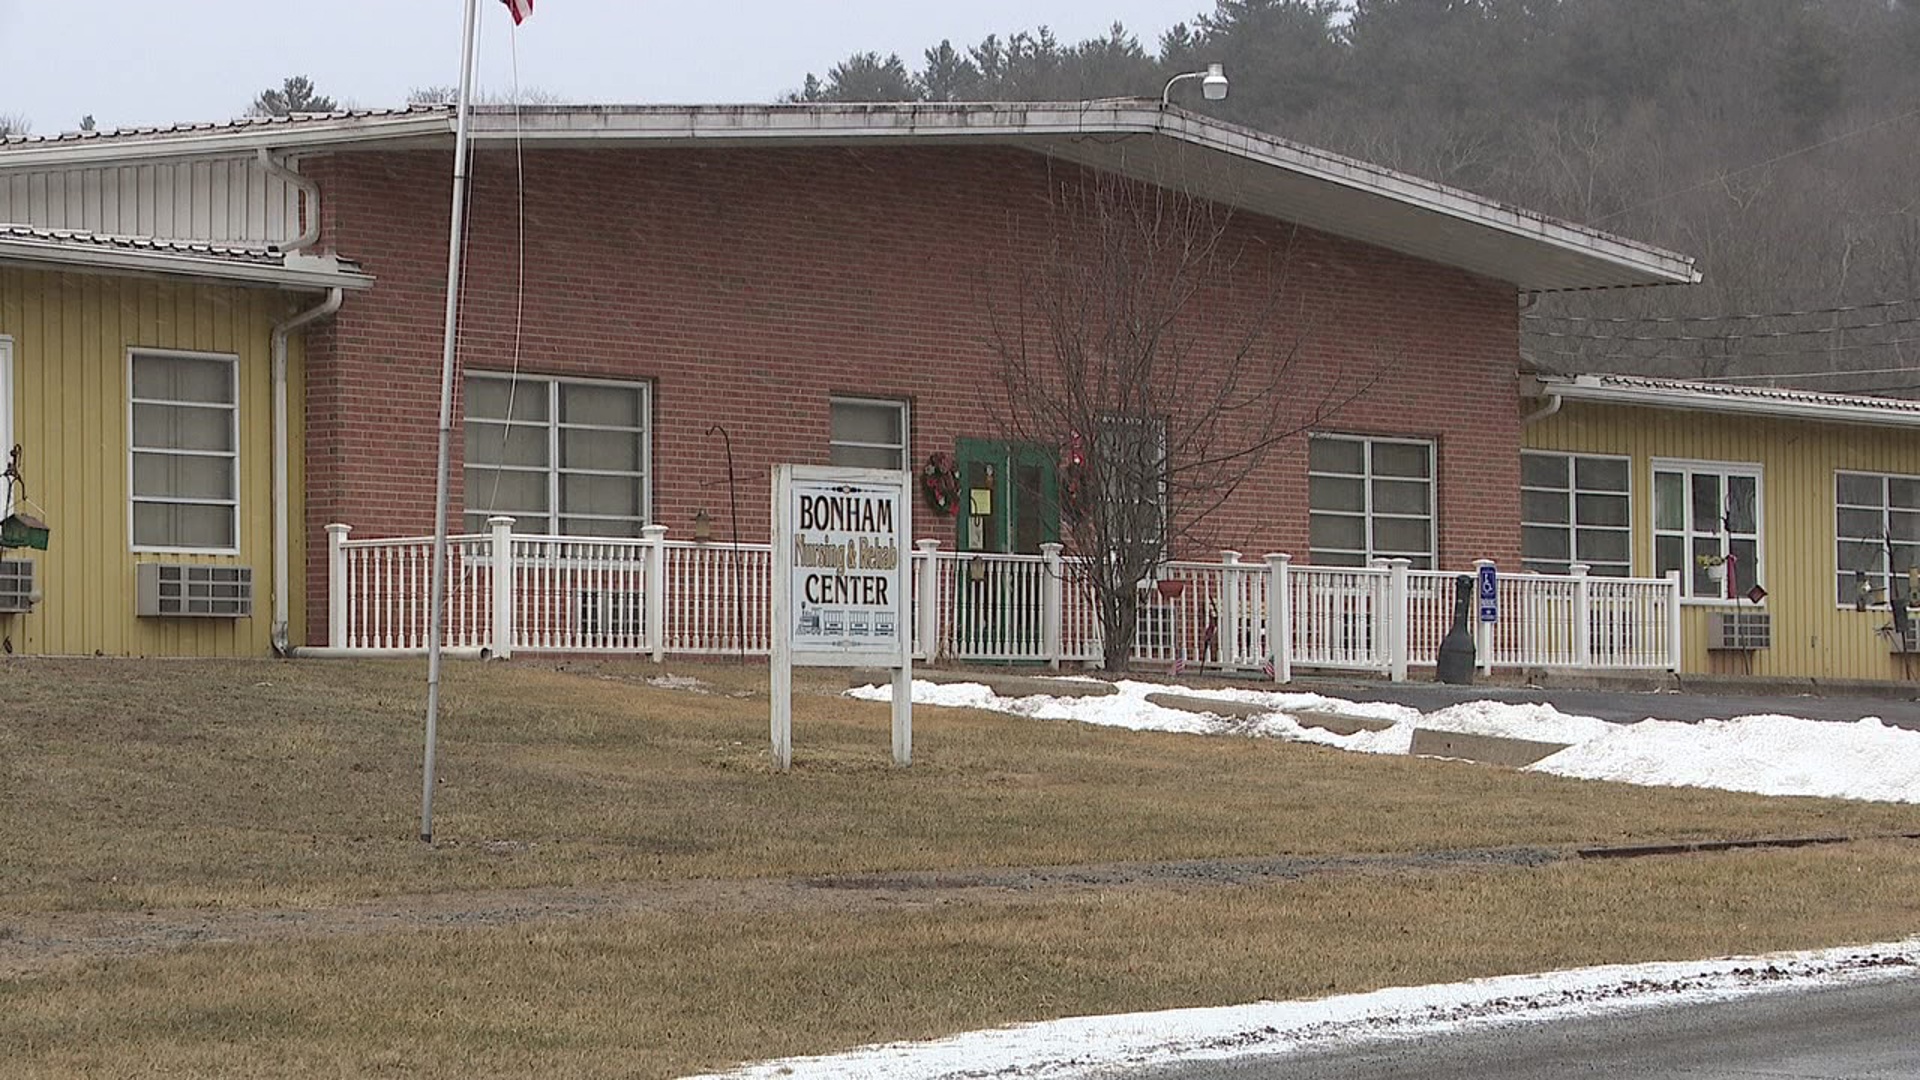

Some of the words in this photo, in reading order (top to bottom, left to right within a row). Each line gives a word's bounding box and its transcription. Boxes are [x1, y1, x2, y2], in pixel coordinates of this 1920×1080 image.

[800, 495, 893, 533] BONHAM
[794, 534, 846, 575] Nursing
[847, 539, 857, 569] &
[859, 536, 898, 570] Rehab
[805, 574, 888, 605] CENTER
